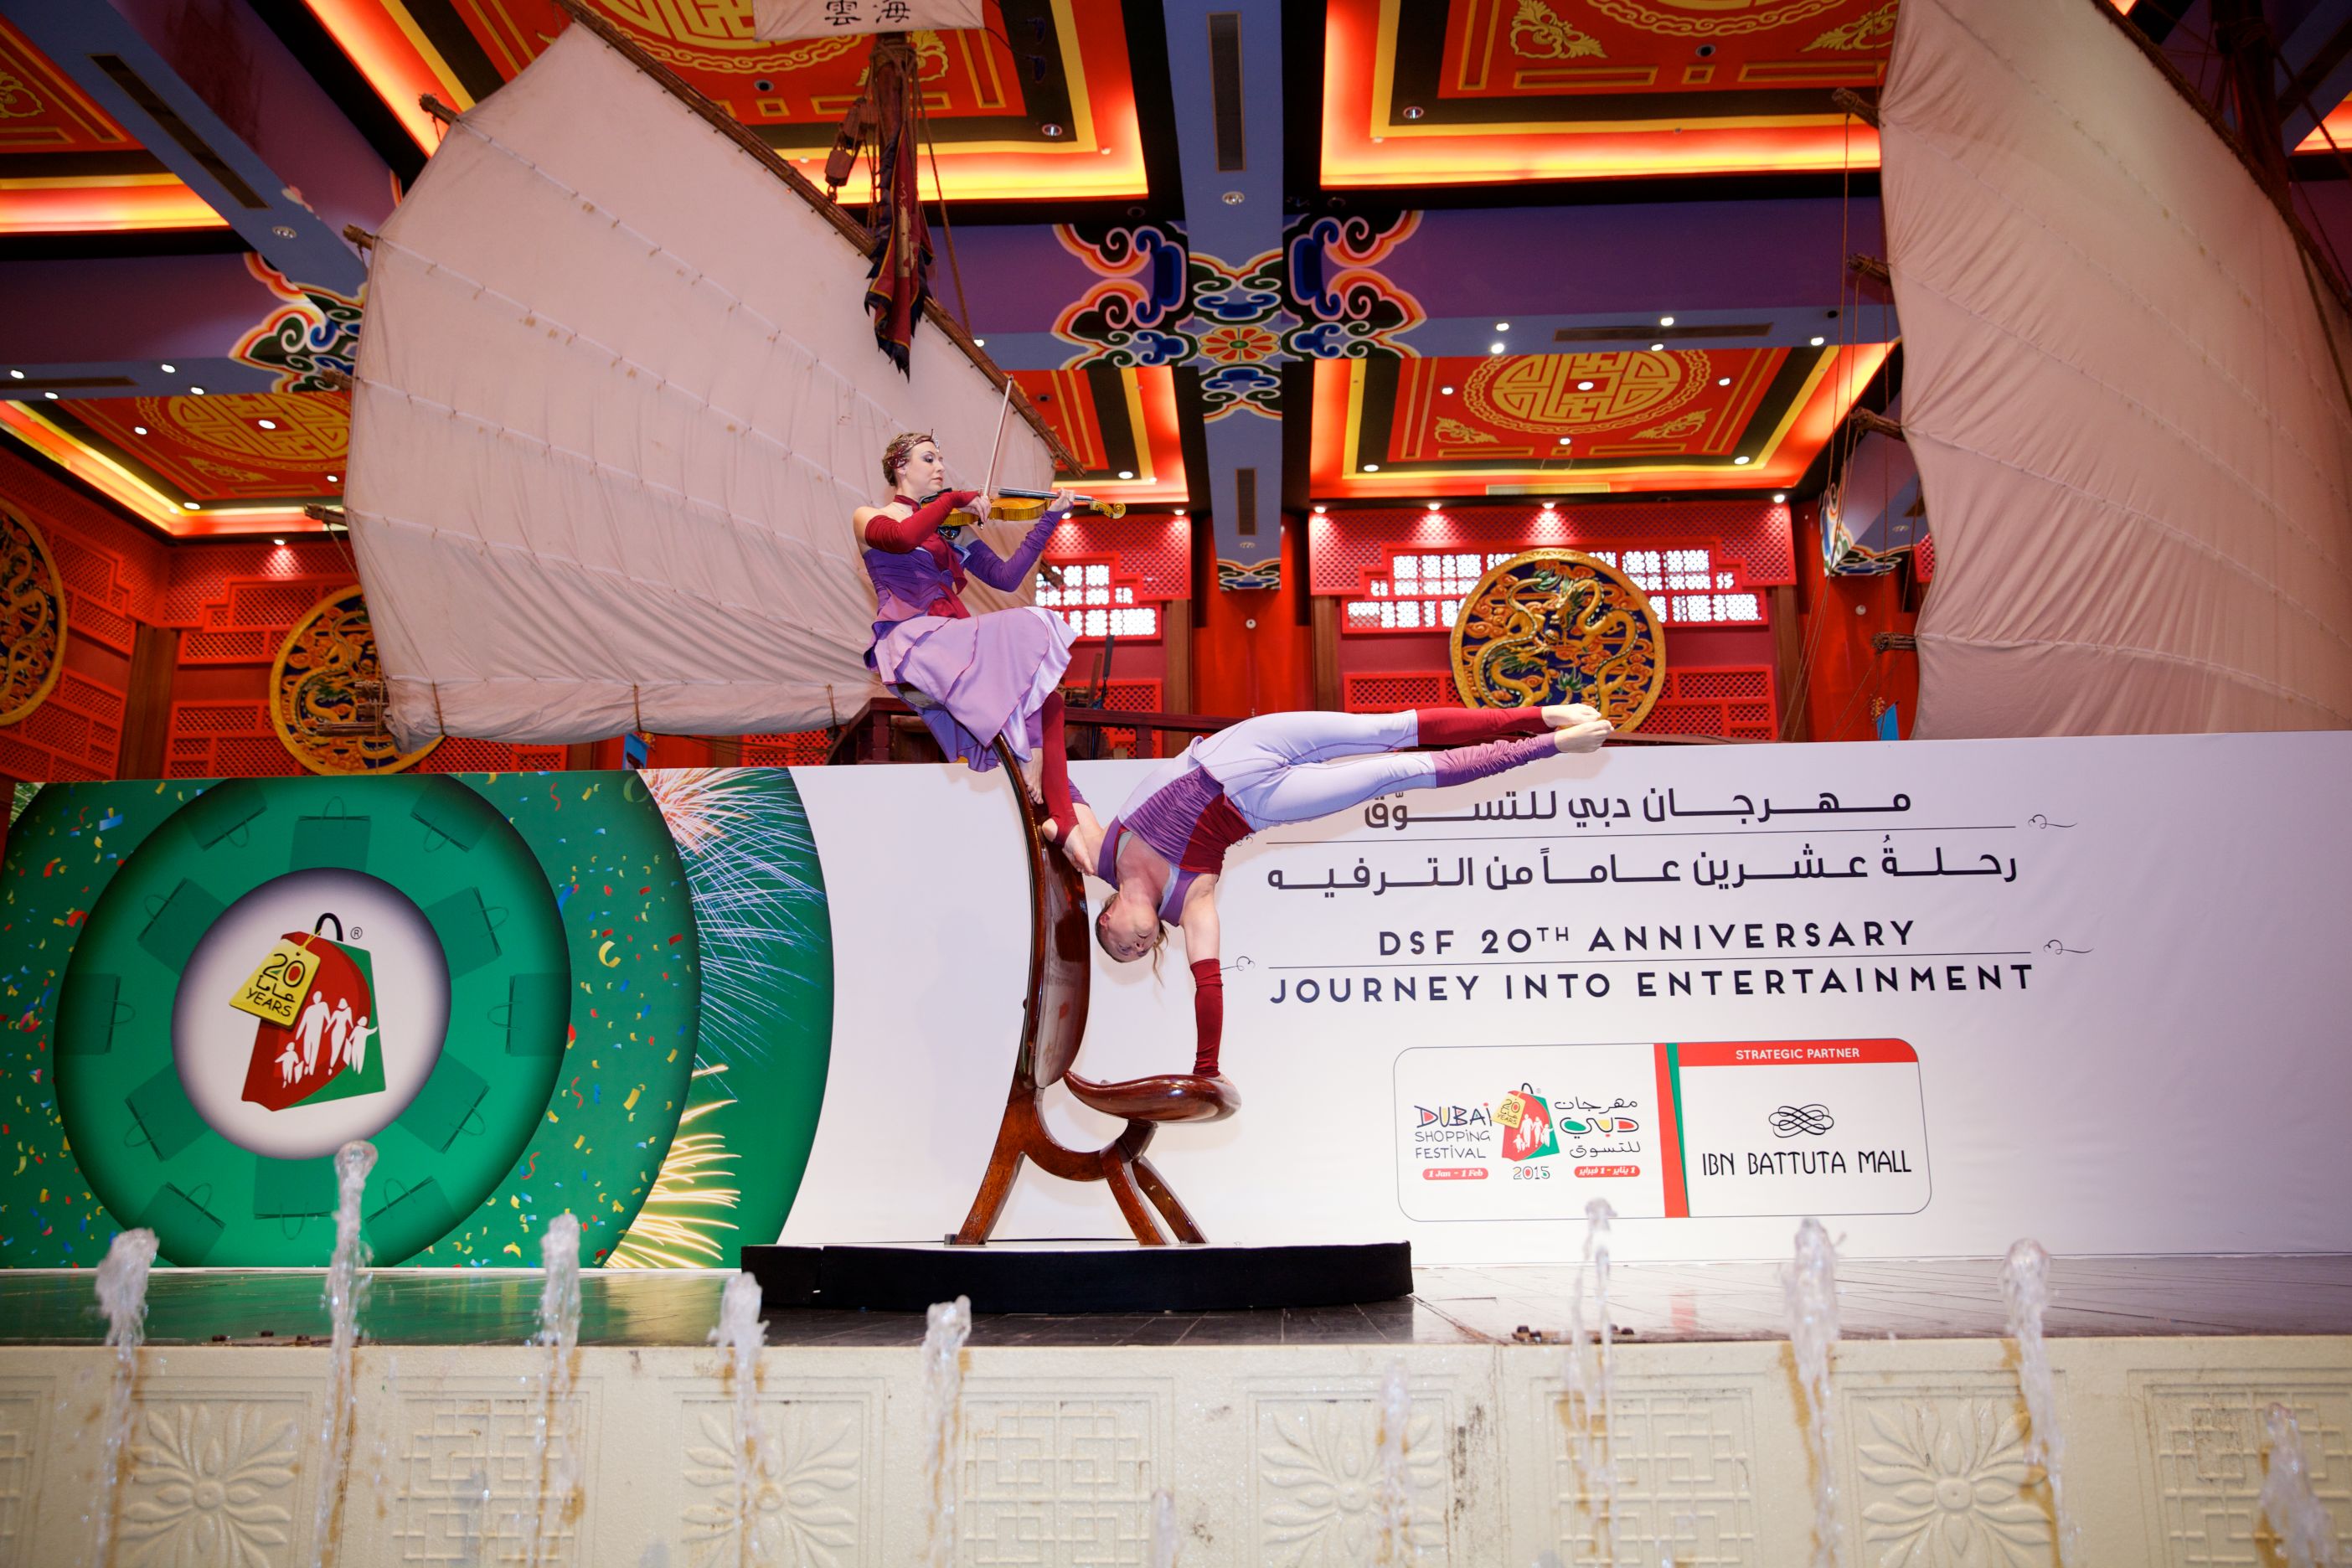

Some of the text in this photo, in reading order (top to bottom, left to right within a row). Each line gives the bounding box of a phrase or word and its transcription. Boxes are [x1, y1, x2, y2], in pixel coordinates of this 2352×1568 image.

[1568, 797, 1630, 828] دبي
[1643, 787, 1911, 825] مهرجان
[1267, 856, 1473, 898] الترفيه
[1486, 855, 1533, 890] من
[1693, 843, 1868, 890] عشرين
[1379, 930, 1454, 956] DSF
[1588, 920, 1914, 952] ANNIVERSARY
[262, 952, 306, 988] 20
[1270, 964, 2032, 1003] JOURNEY INTO ENTERTAINMENT
[246, 987, 291, 1017] YEARS
[1736, 1048, 1859, 1060] STRATEGIC PARTNER
[1498, 1113, 1517, 1125] YEARS
[1502, 1099, 1520, 1113] 20
[1555, 1096, 1638, 1114] مهرجان
[1560, 1117, 1639, 1139] دبي
[1570, 1142, 1640, 1158] للتسوق
[1703, 1150, 1911, 1176] IBN BATTUTA MALL
[1461, 1169, 1467, 1178] 1
[1467, 1169, 1483, 1178] Feb
[1513, 1166, 1550, 1179] 2015
